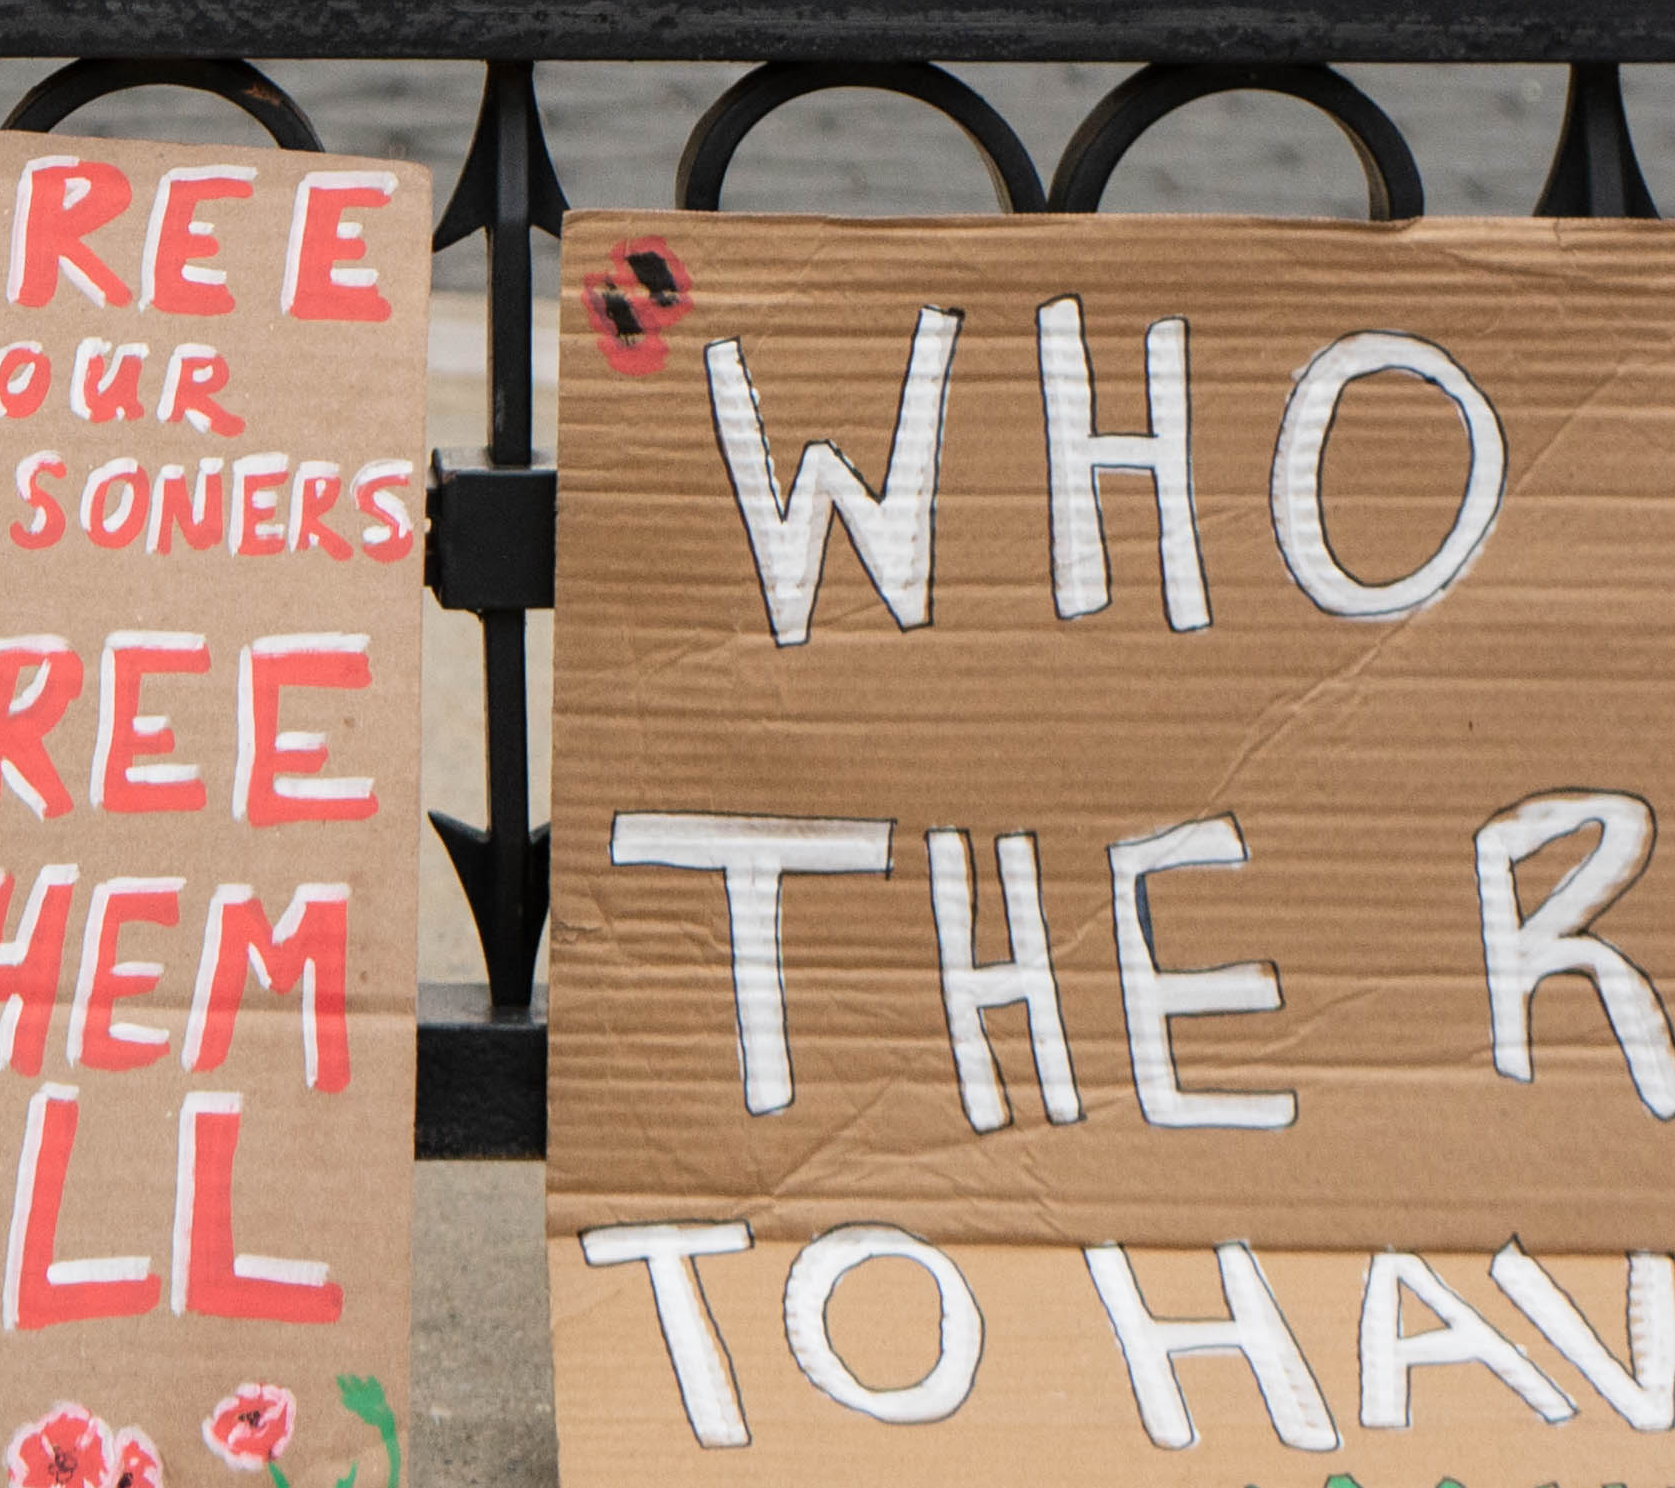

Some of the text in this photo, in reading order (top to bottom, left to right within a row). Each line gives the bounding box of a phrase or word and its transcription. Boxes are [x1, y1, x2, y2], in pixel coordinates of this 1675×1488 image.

[703, 297, 1507, 648] WHO
[607, 810, 1297, 1130] THE
[579, 1220, 985, 1450] TO
